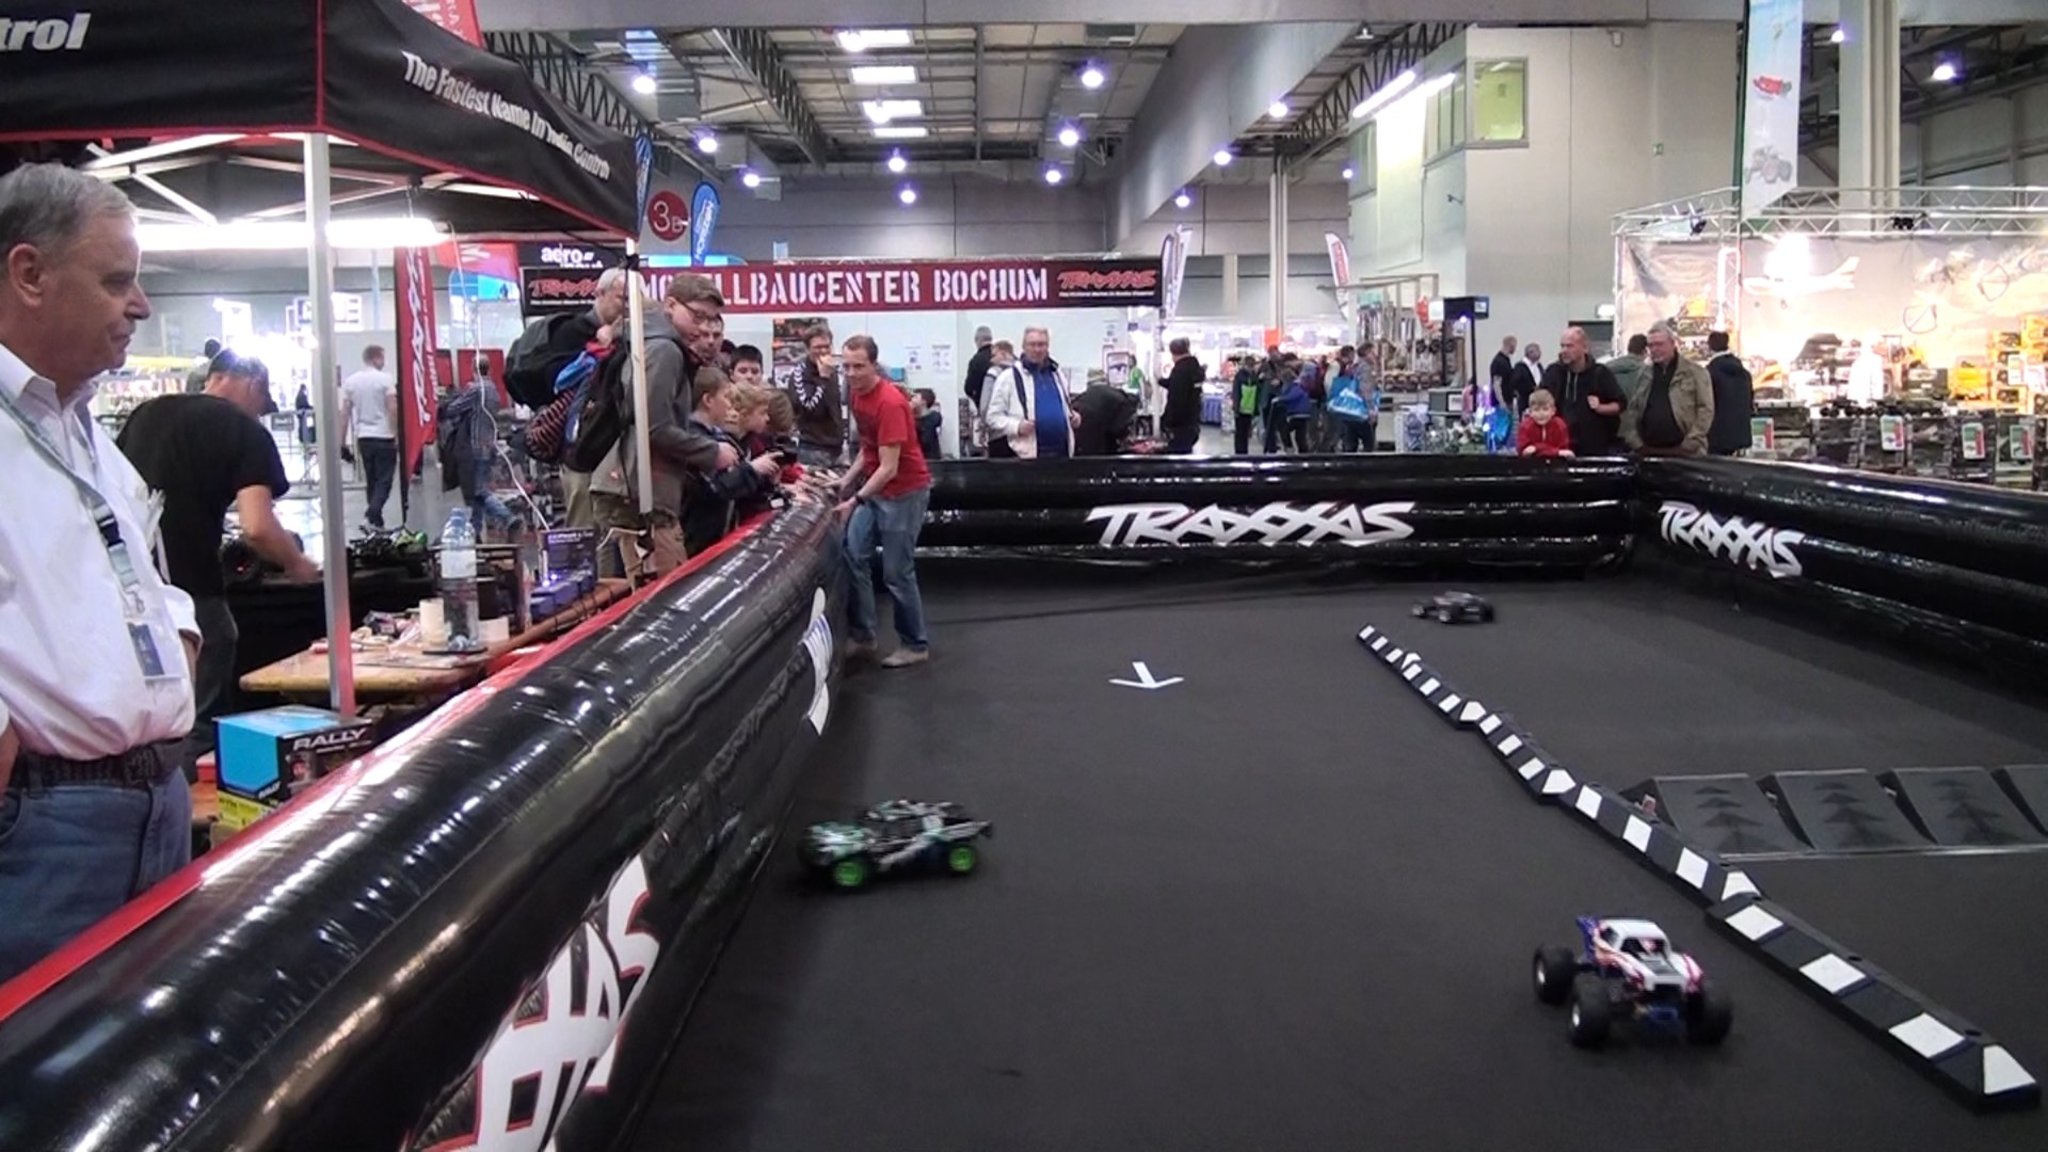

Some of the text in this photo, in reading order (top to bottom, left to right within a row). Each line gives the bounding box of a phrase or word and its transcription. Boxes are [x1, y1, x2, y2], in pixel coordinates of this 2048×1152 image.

[401, 50, 438, 92] The
[435, 66, 492, 117] Fastest
[490, 94, 531, 132] Name
[934, 268, 1047, 302] BOCHUM
[1084, 501, 1416, 548] TRAXXAS
[1658, 501, 1805, 578] TRAXXAS
[293, 728, 367, 751] RALLY
